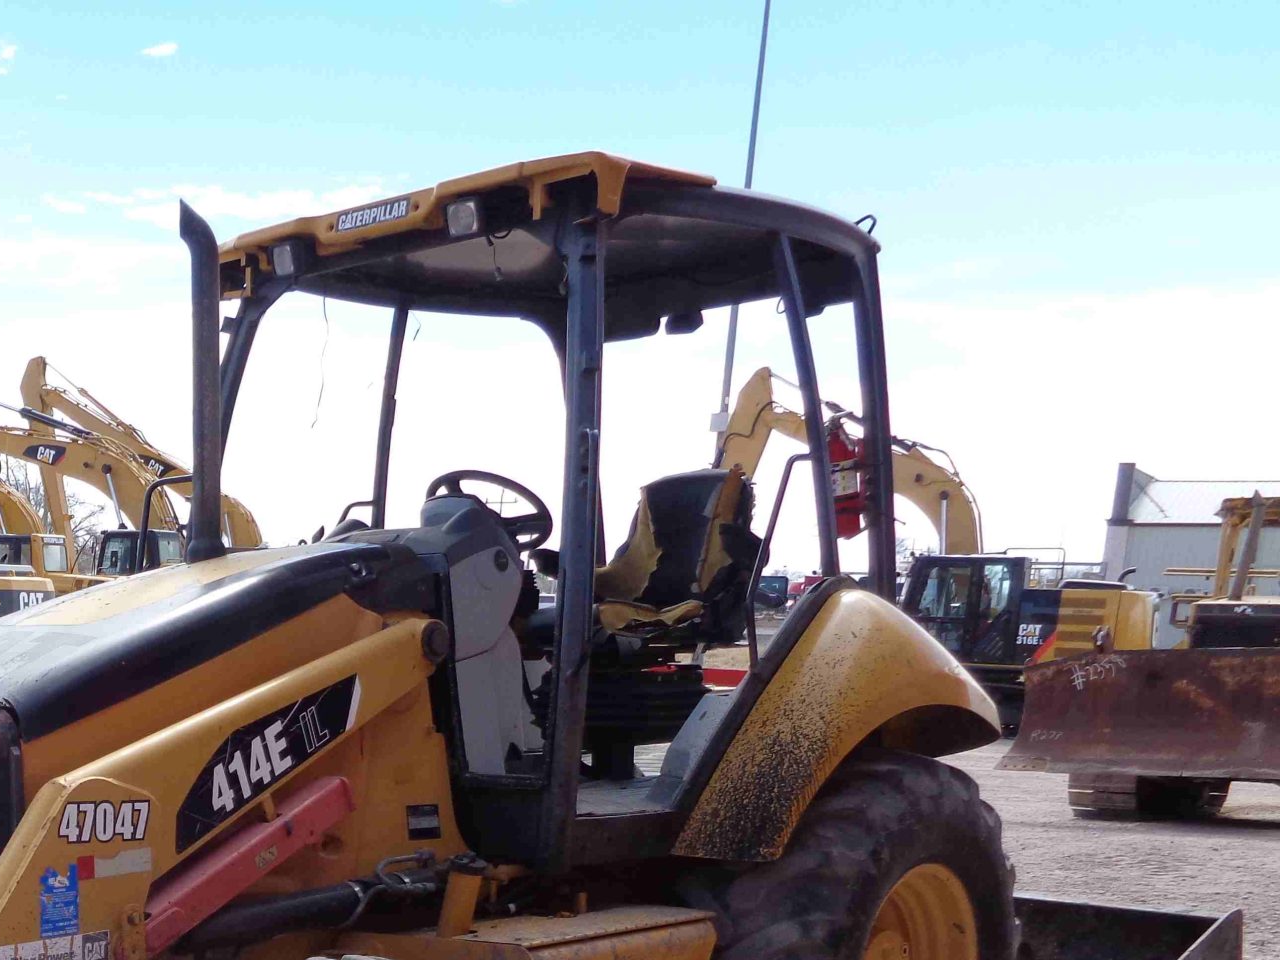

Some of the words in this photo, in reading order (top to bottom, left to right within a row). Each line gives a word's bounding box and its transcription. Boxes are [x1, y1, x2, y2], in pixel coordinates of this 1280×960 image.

[338, 200, 407, 230] CATERPILLAR
[36, 446, 56, 464] CAT
[147, 459, 164, 477] CAT
[1018, 624, 1042, 636] CAT
[211, 719, 293, 812] 414E
[58, 800, 150, 843] 47047
[84, 940, 106, 960] CAT
